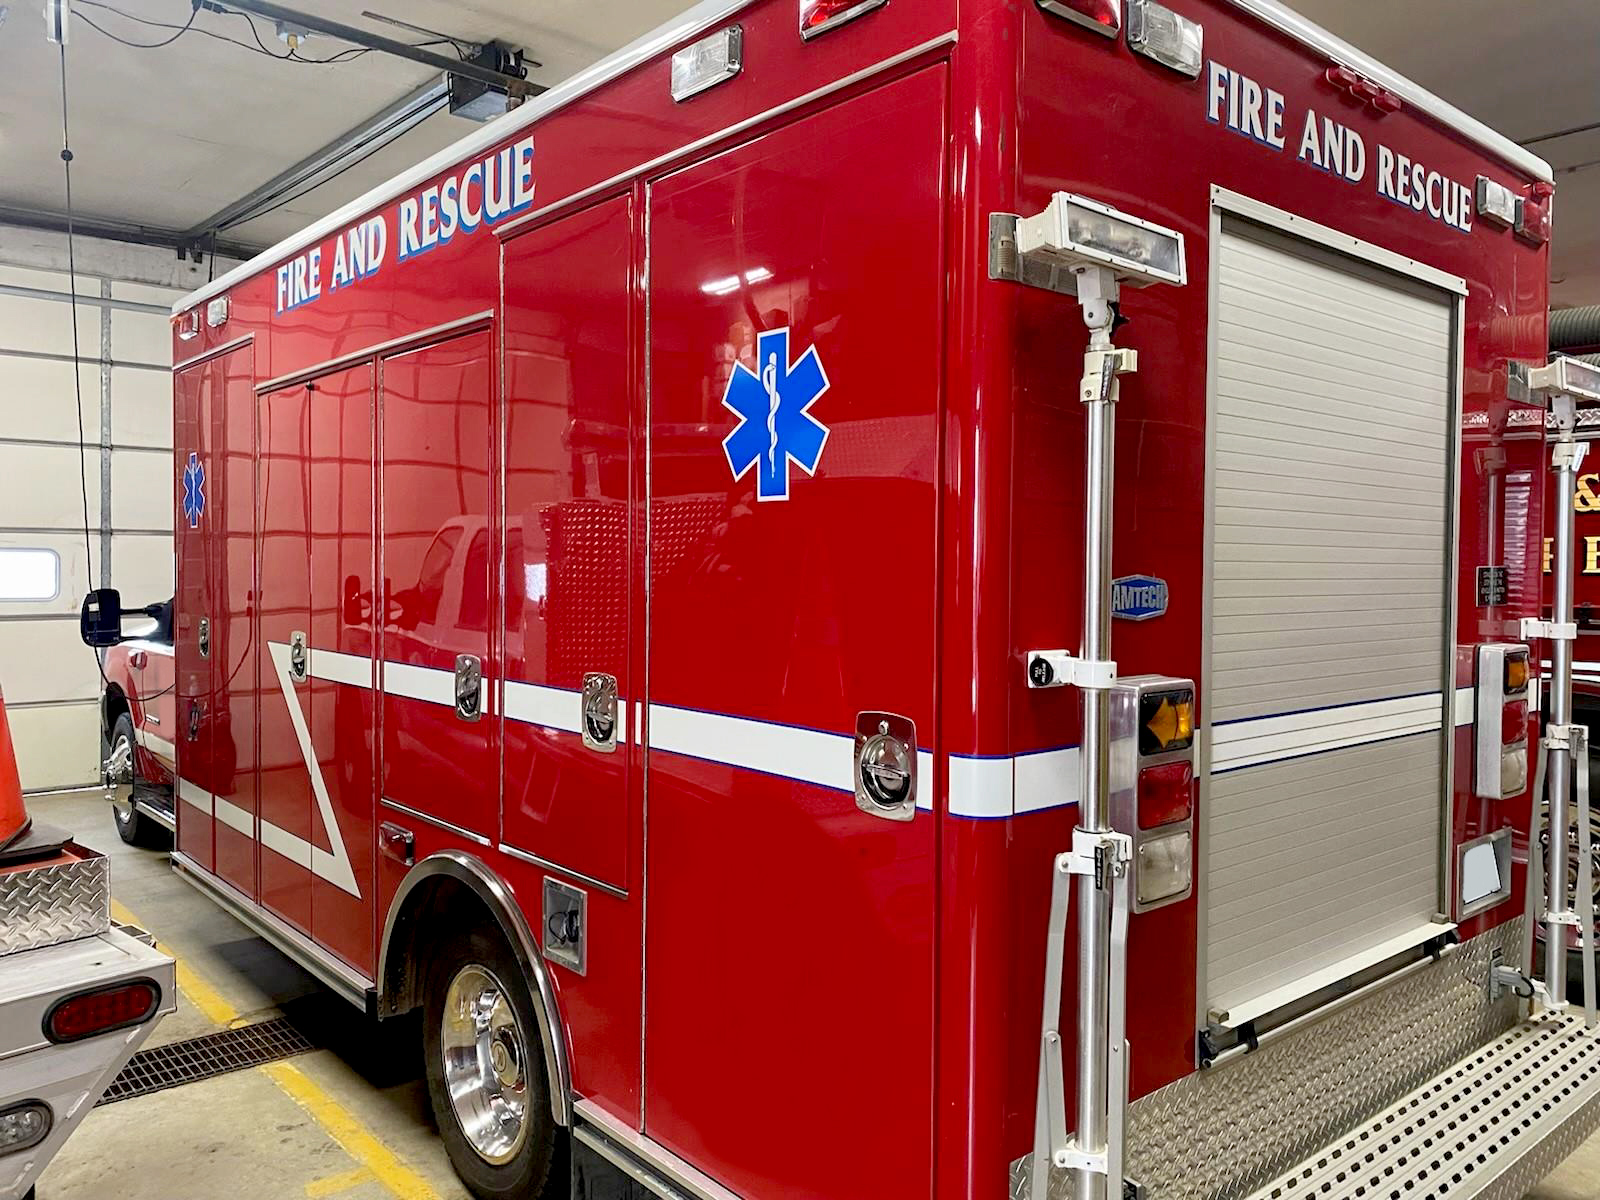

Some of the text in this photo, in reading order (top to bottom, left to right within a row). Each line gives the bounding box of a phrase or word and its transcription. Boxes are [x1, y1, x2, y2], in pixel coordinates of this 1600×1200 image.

[276, 135, 536, 316] FIRE AND RESCUE
[1207, 59, 1473, 234] FIRE AND RESCUE
[1112, 584, 1165, 611] AMTECH
